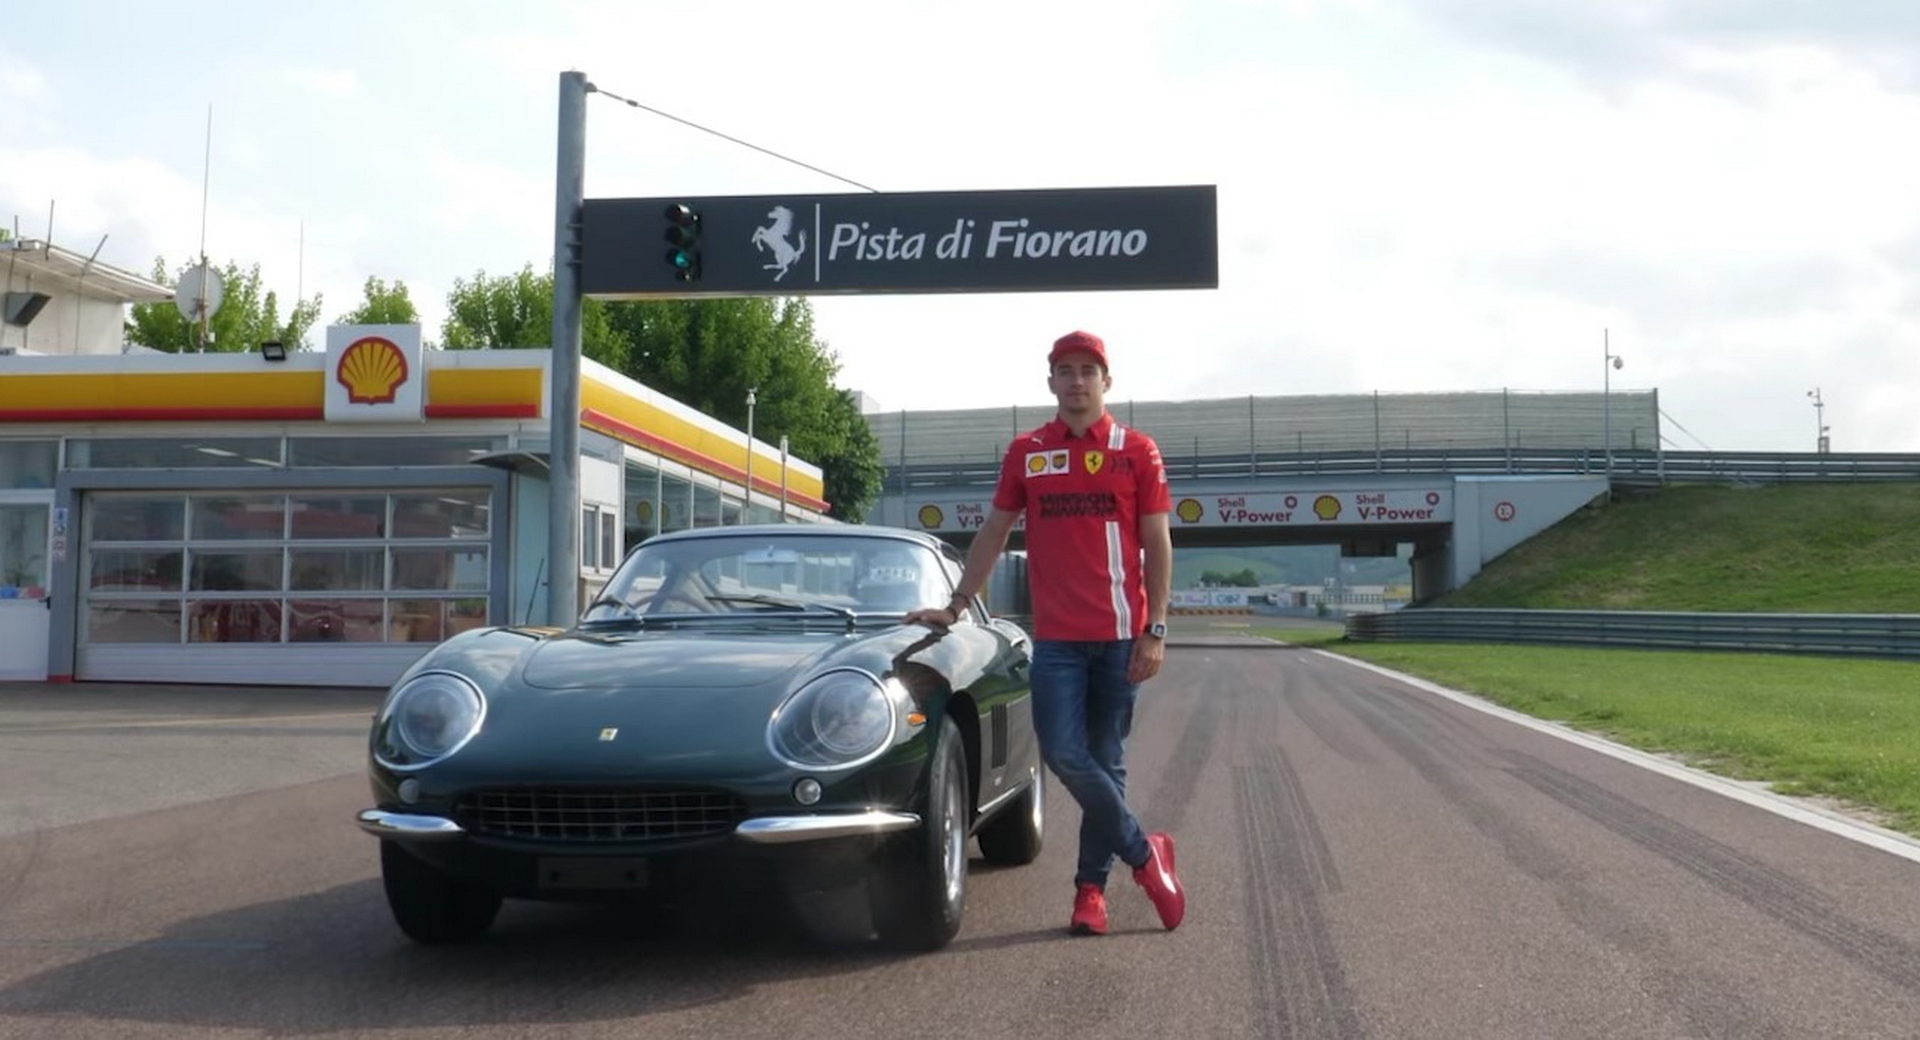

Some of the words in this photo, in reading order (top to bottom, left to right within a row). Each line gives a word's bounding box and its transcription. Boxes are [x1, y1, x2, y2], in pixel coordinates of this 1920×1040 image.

[828, 222, 926, 261] Pista
[936, 218, 975, 259] di
[984, 218, 1147, 259] Fiorano
[1217, 497, 1245, 508] Shell
[1356, 493, 1385, 505] Shell
[956, 504, 982, 514] Shell
[1357, 506, 1434, 520] V-Power
[1218, 509, 1292, 523] V-Power
